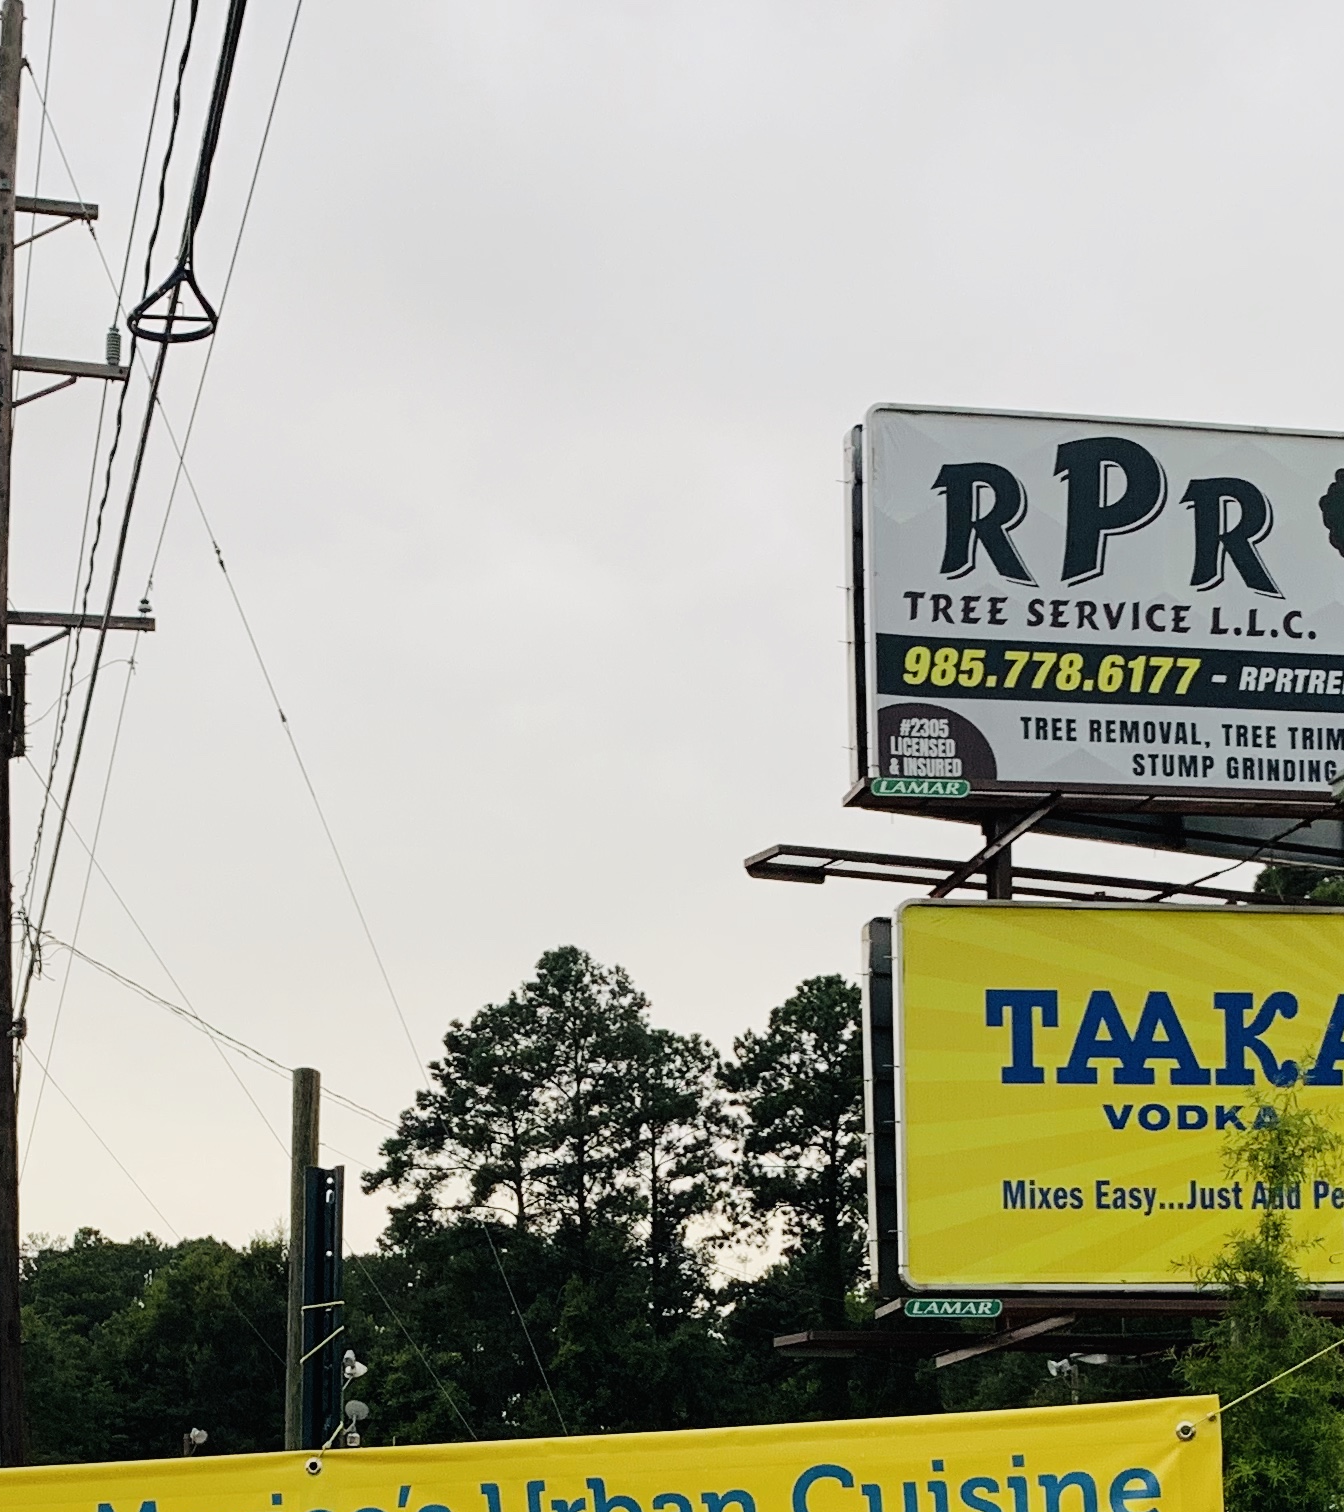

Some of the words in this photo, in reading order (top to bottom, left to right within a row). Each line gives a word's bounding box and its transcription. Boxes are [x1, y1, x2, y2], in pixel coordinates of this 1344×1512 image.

[930, 436, 1286, 600] RPR
[903, 590, 1009, 626] TREE
[1027, 600, 1193, 634] SERVICE
[1208, 606, 1318, 641] L.L.C.
[902, 645, 1202, 696] 985.778.6177
[899, 717, 950, 738] #2305
[1020, 716, 1078, 743] TREE
[1089, 718, 1212, 750] REMOVAL,
[1221, 723, 1277, 749] TREE
[890, 735, 957, 758] LICENSED
[888, 757, 900, 776] &
[903, 757, 963, 778] INSURED
[1132, 753, 1215, 779] STUMP
[1226, 756, 1338, 784] GRINDING
[879, 780, 961, 795] LAMAR
[1103, 1103, 1282, 1131] VODKA
[1002, 1179, 1084, 1212] Mixes
[912, 1301, 993, 1314] LAMAR
